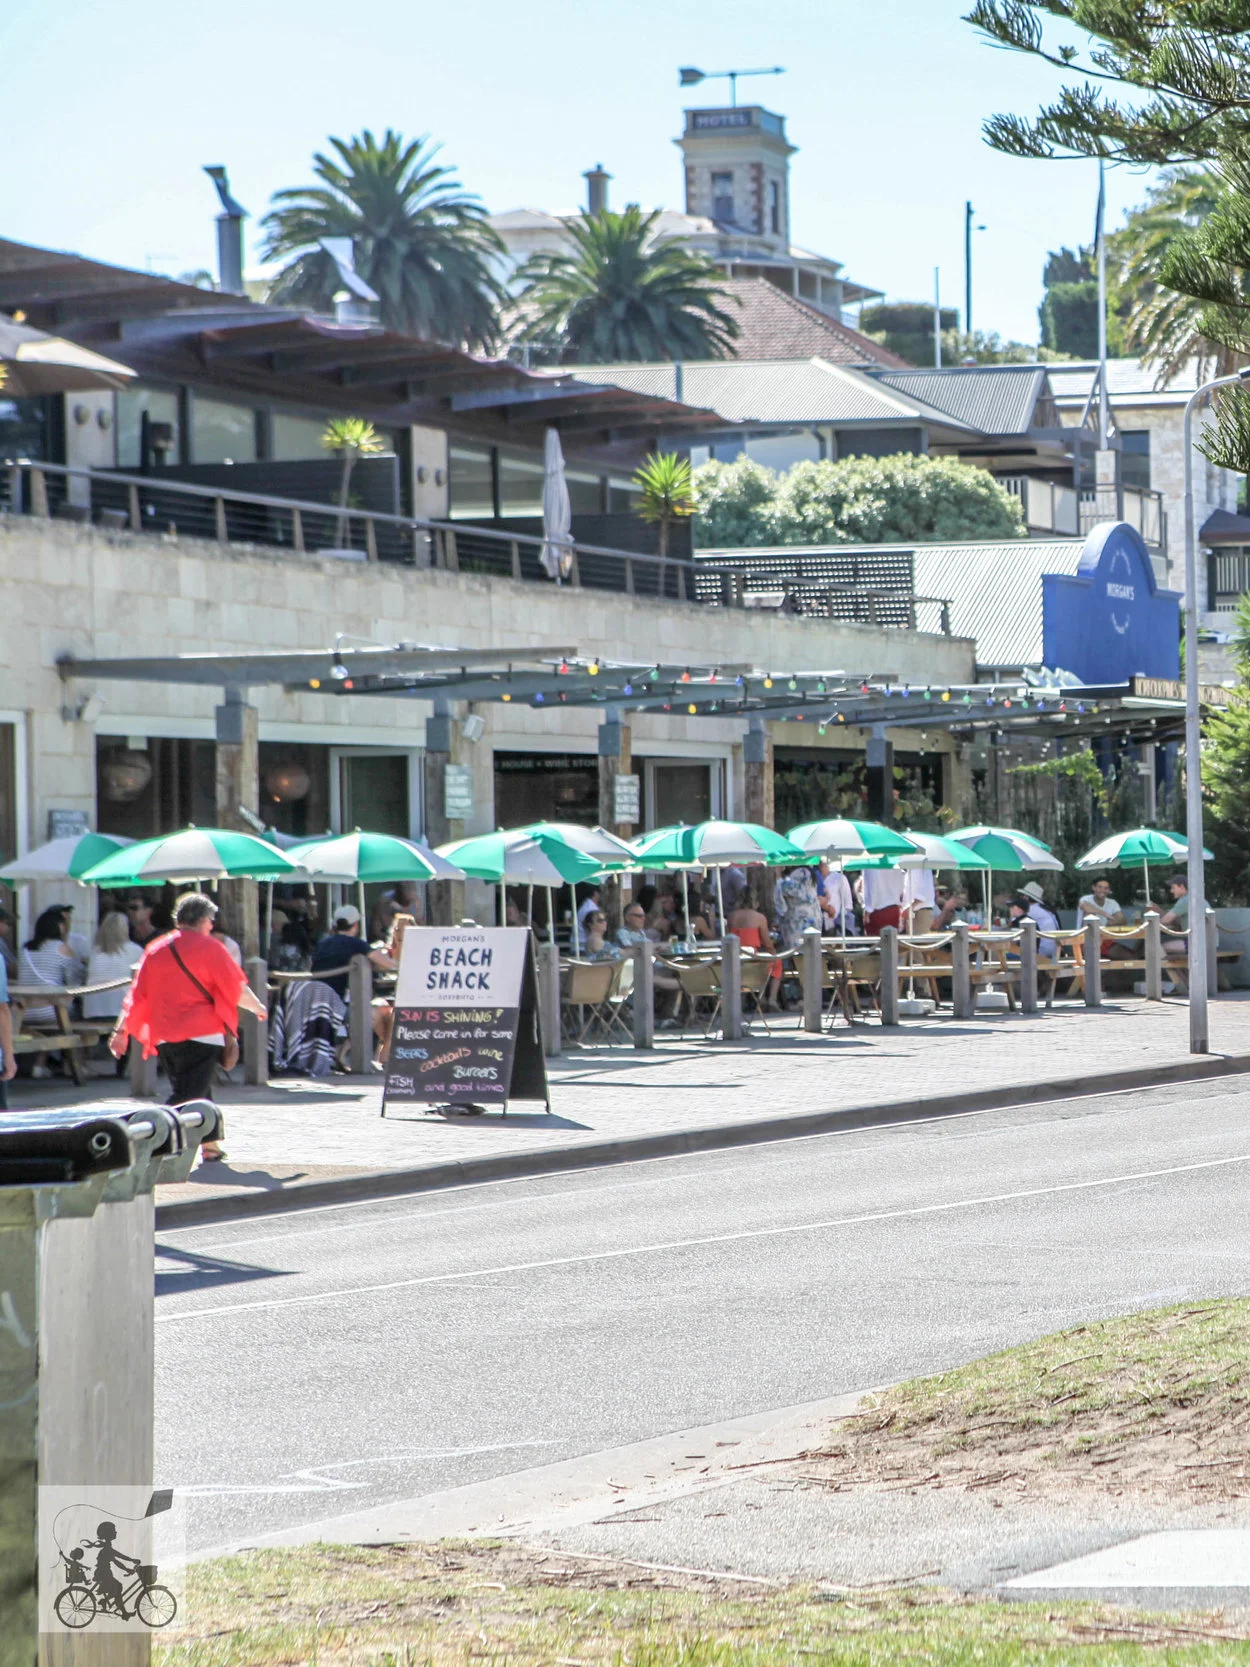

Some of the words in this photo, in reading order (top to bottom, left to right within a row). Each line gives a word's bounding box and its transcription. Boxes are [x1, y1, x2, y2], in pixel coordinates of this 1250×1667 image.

[572, 758, 598, 769] STOR
[430, 948, 493, 967] BEACH
[426, 971, 490, 990] SHACK
[400, 1010, 422, 1022] SUN
[426, 1010, 440, 1022] IS
[396, 1026, 431, 1041] Please
[433, 1029, 459, 1039] come
[460, 1029, 472, 1039] in
[473, 1027, 488, 1039] for
[491, 1030, 513, 1040] some
